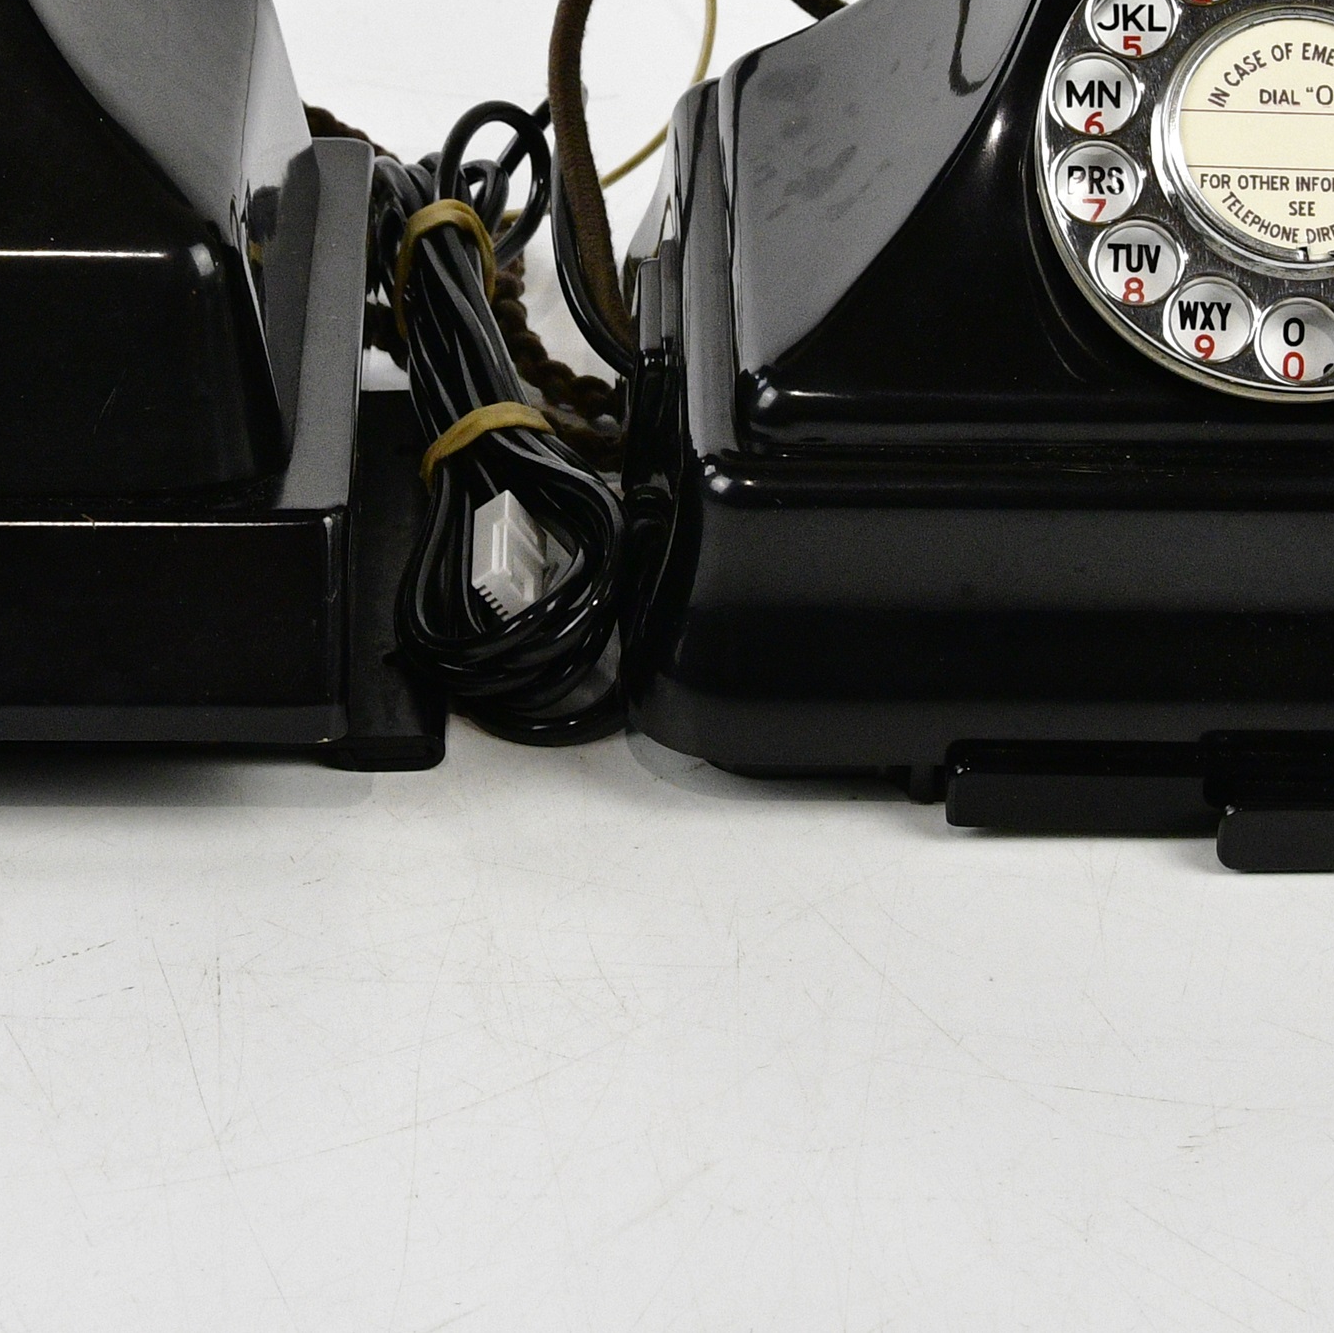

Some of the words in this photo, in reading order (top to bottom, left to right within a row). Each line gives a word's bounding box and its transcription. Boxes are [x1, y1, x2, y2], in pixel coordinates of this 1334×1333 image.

[1097, 3, 1167, 32] JKL
[1122, 35, 1142, 57] 5
[1208, 87, 1230, 108] IN
[1224, 50, 1267, 87] CASE
[1271, 42, 1293, 62] OF
[1065, 80, 1121, 109] MN
[1260, 88, 1301, 106] DIAL
[1084, 111, 1104, 134] 6
[1200, 173, 1231, 189] FOR
[1237, 174, 1290, 191] OTHER
[1082, 198, 1107, 222] 7
[1222, 191, 1300, 243] TELEPHONE
[1289, 201, 1315, 217] SEE
[1107, 243, 1161, 274] TUV
[1122, 277, 1145, 303] 8
[1178, 300, 1231, 331] WXY
[1194, 334, 1215, 360] 9
